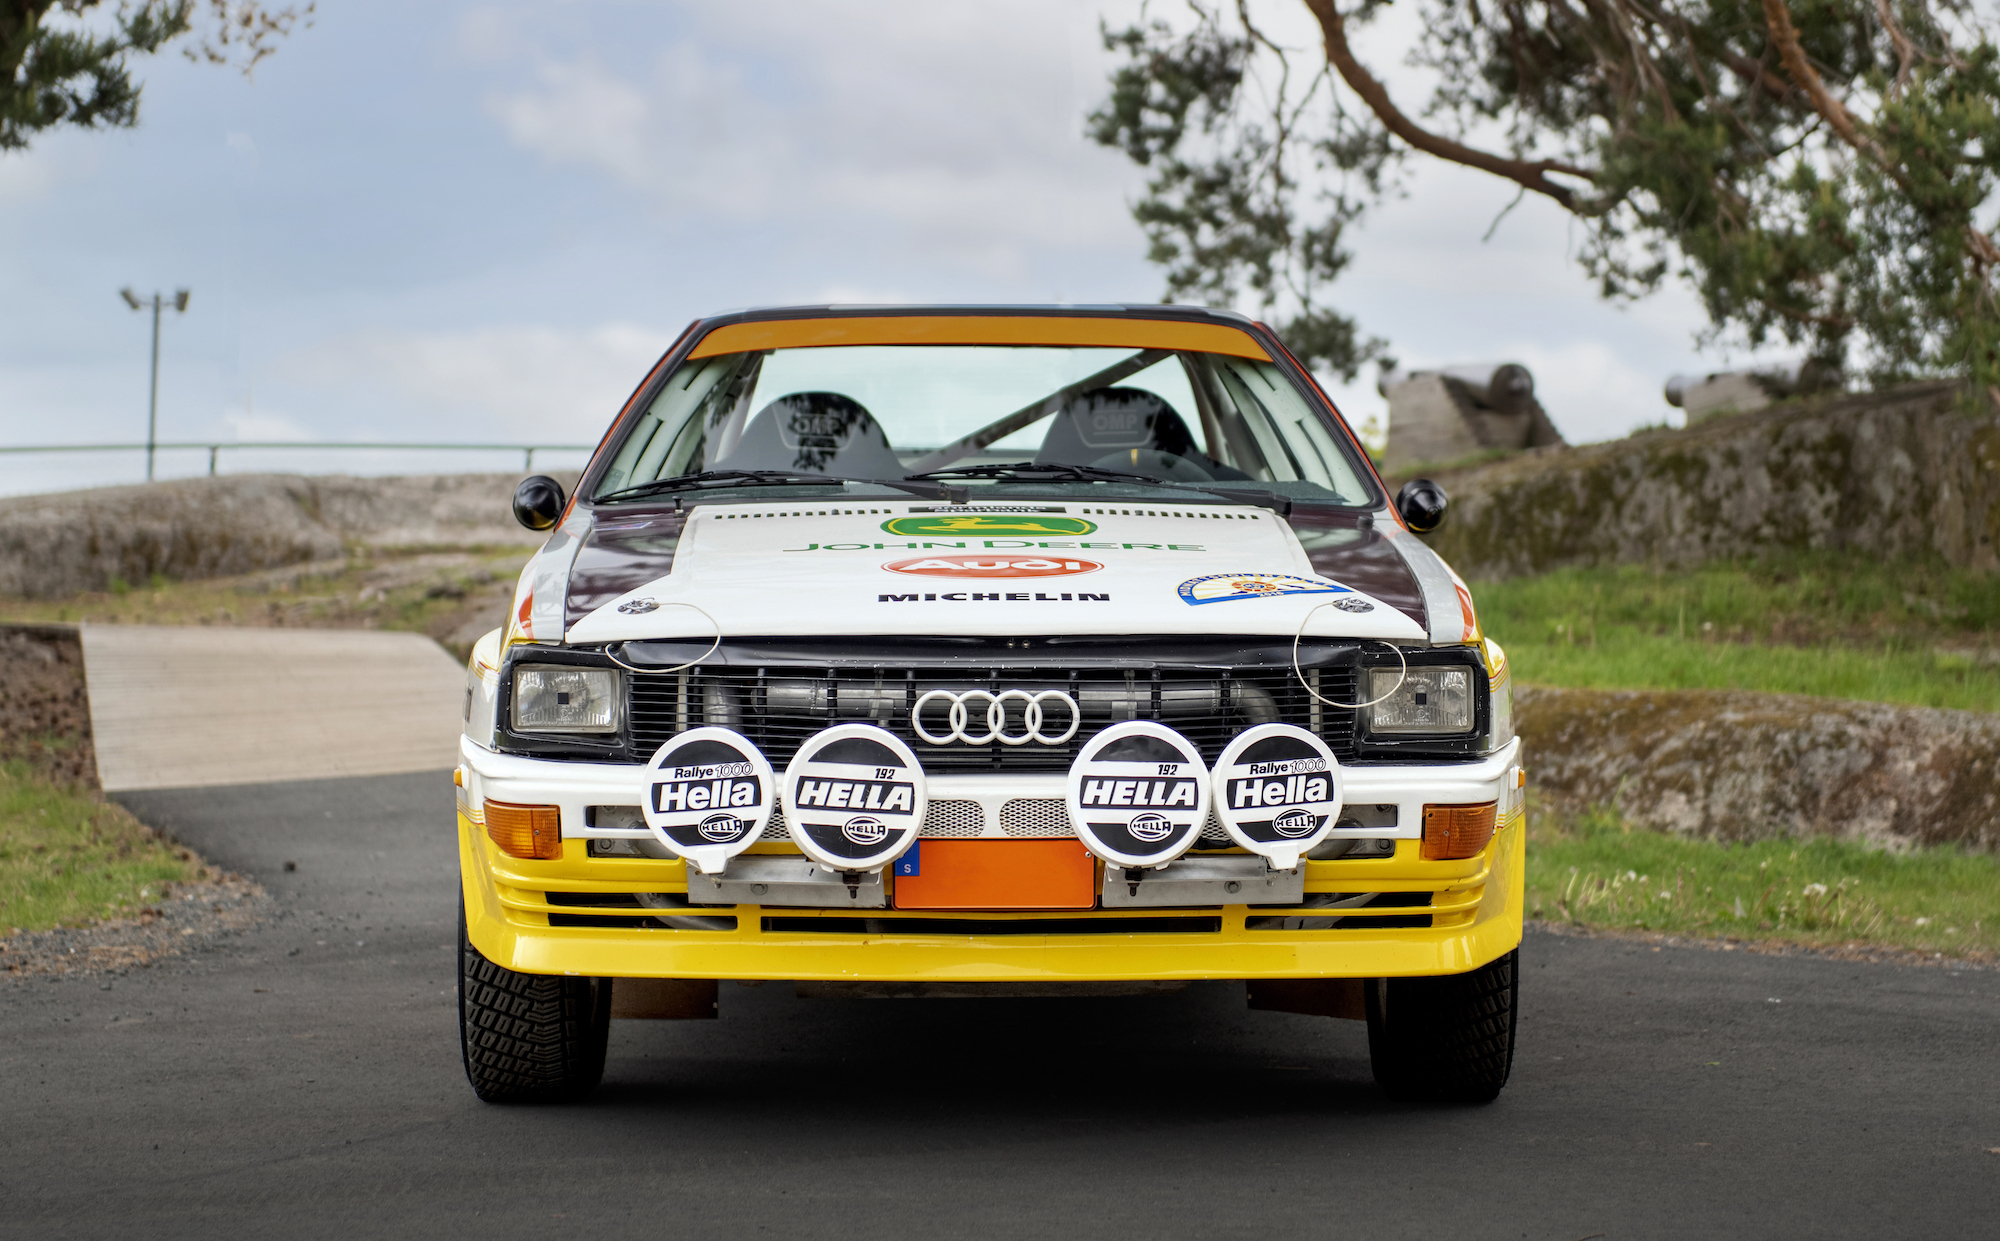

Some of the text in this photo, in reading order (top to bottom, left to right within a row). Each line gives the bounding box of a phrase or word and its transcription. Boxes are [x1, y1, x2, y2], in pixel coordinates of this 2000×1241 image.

[1093, 413, 1138, 431] OMP
[783, 540, 1206, 552] JOHN DEERE
[878, 592, 1111, 602] MICHELIN
[674, 762, 754, 779] Rallye 1000
[875, 768, 895, 780] 192
[1158, 764, 1178, 776] 192
[1250, 758, 1327, 775] Rallye 1000
[659, 779, 755, 812] Hella
[798, 781, 913, 812] HELLA
[1082, 780, 1196, 807] HELLA
[1234, 777, 1328, 809] Hella
[702, 817, 742, 833] HELLA
[1133, 821, 1171, 833] HELLA
[1277, 814, 1316, 828] HELLA
[848, 824, 886, 837] HELLA
[903, 864, 912, 873] S
